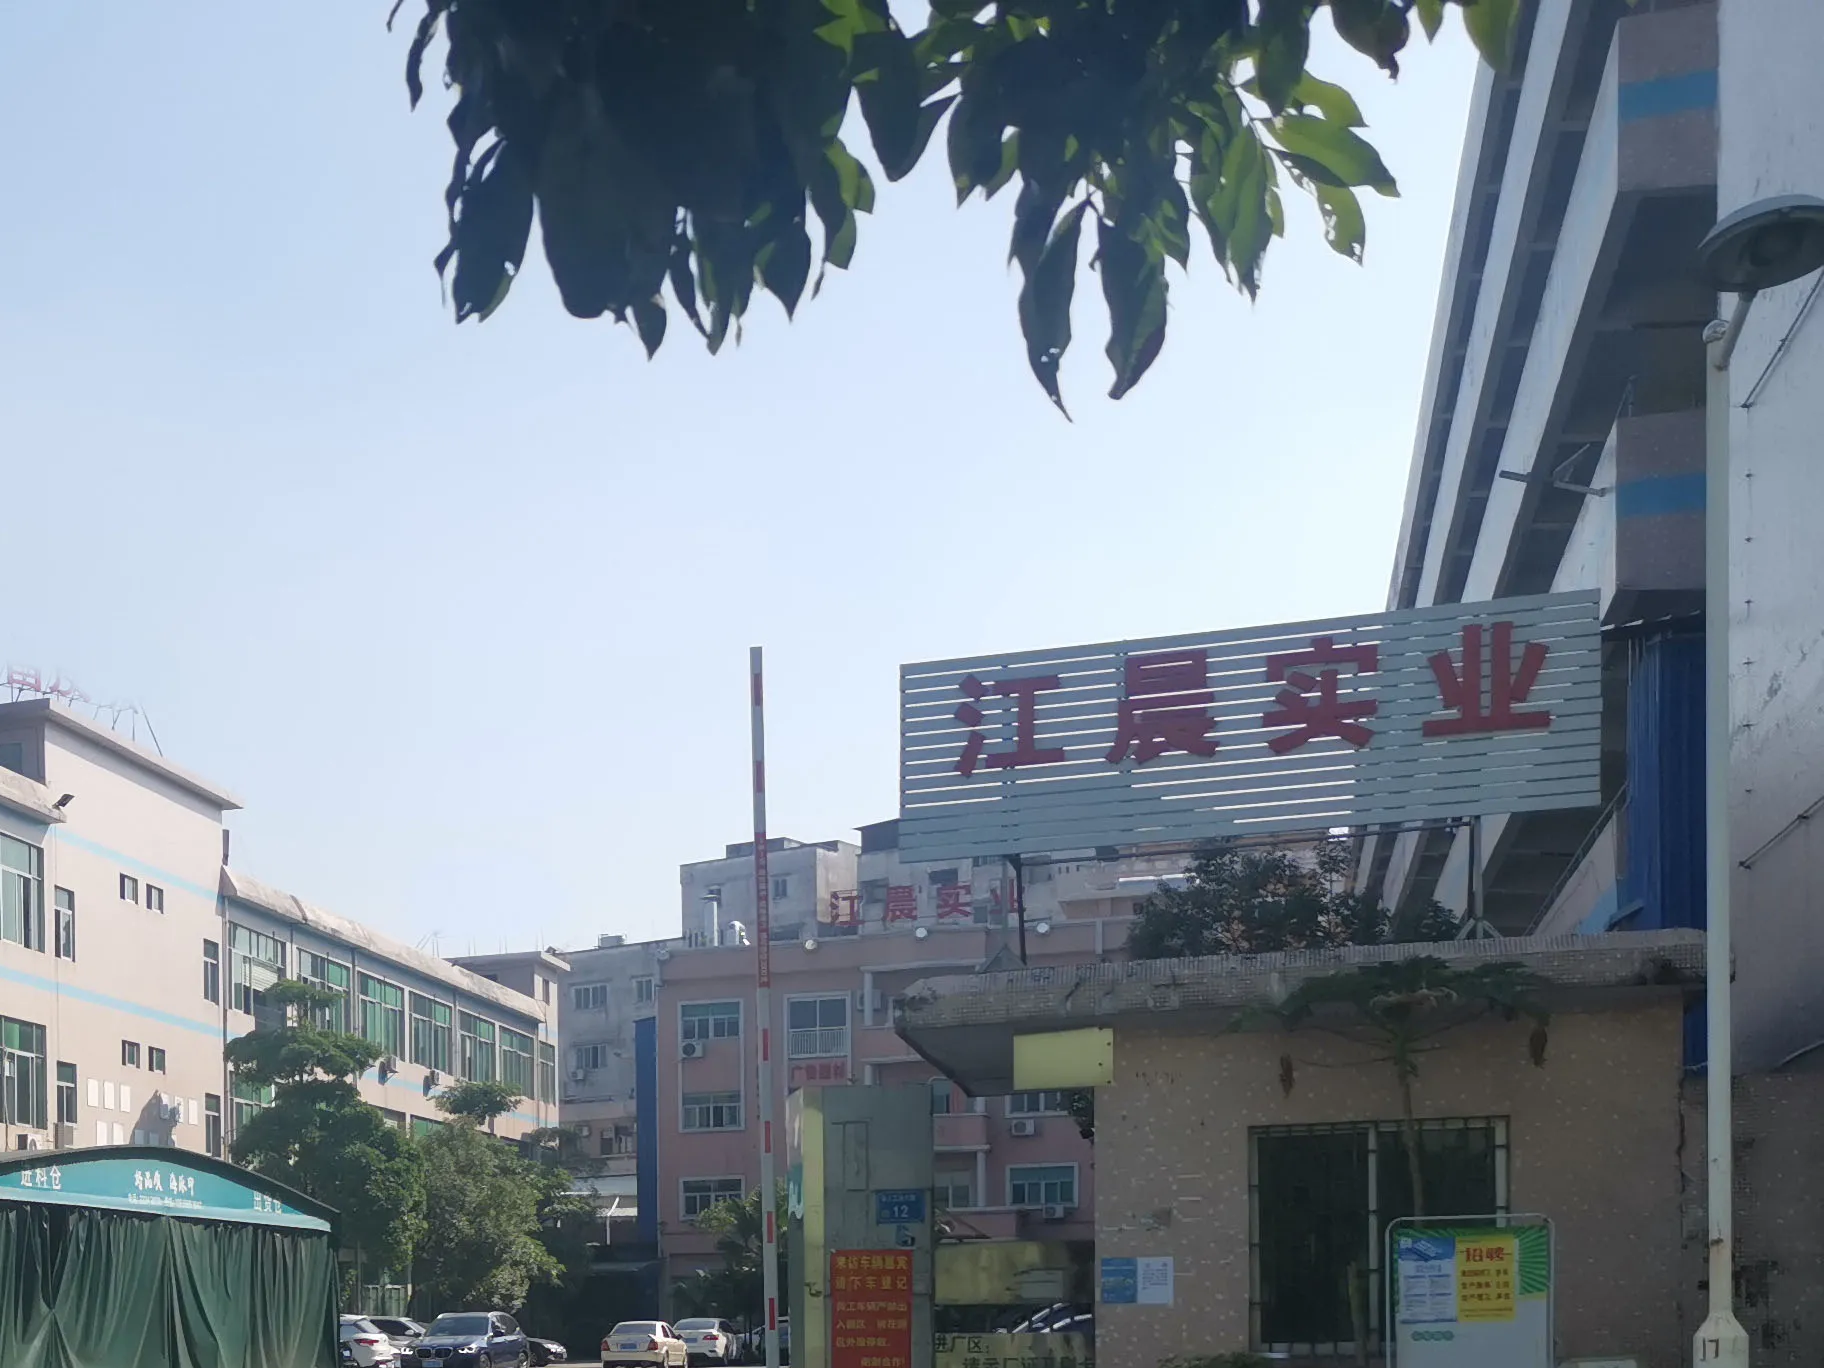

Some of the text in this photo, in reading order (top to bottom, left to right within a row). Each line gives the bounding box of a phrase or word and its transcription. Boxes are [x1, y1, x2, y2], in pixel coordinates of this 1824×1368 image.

[954, 620, 1552, 777] 江晨实业
[893, 1204, 909, 1218] 12
